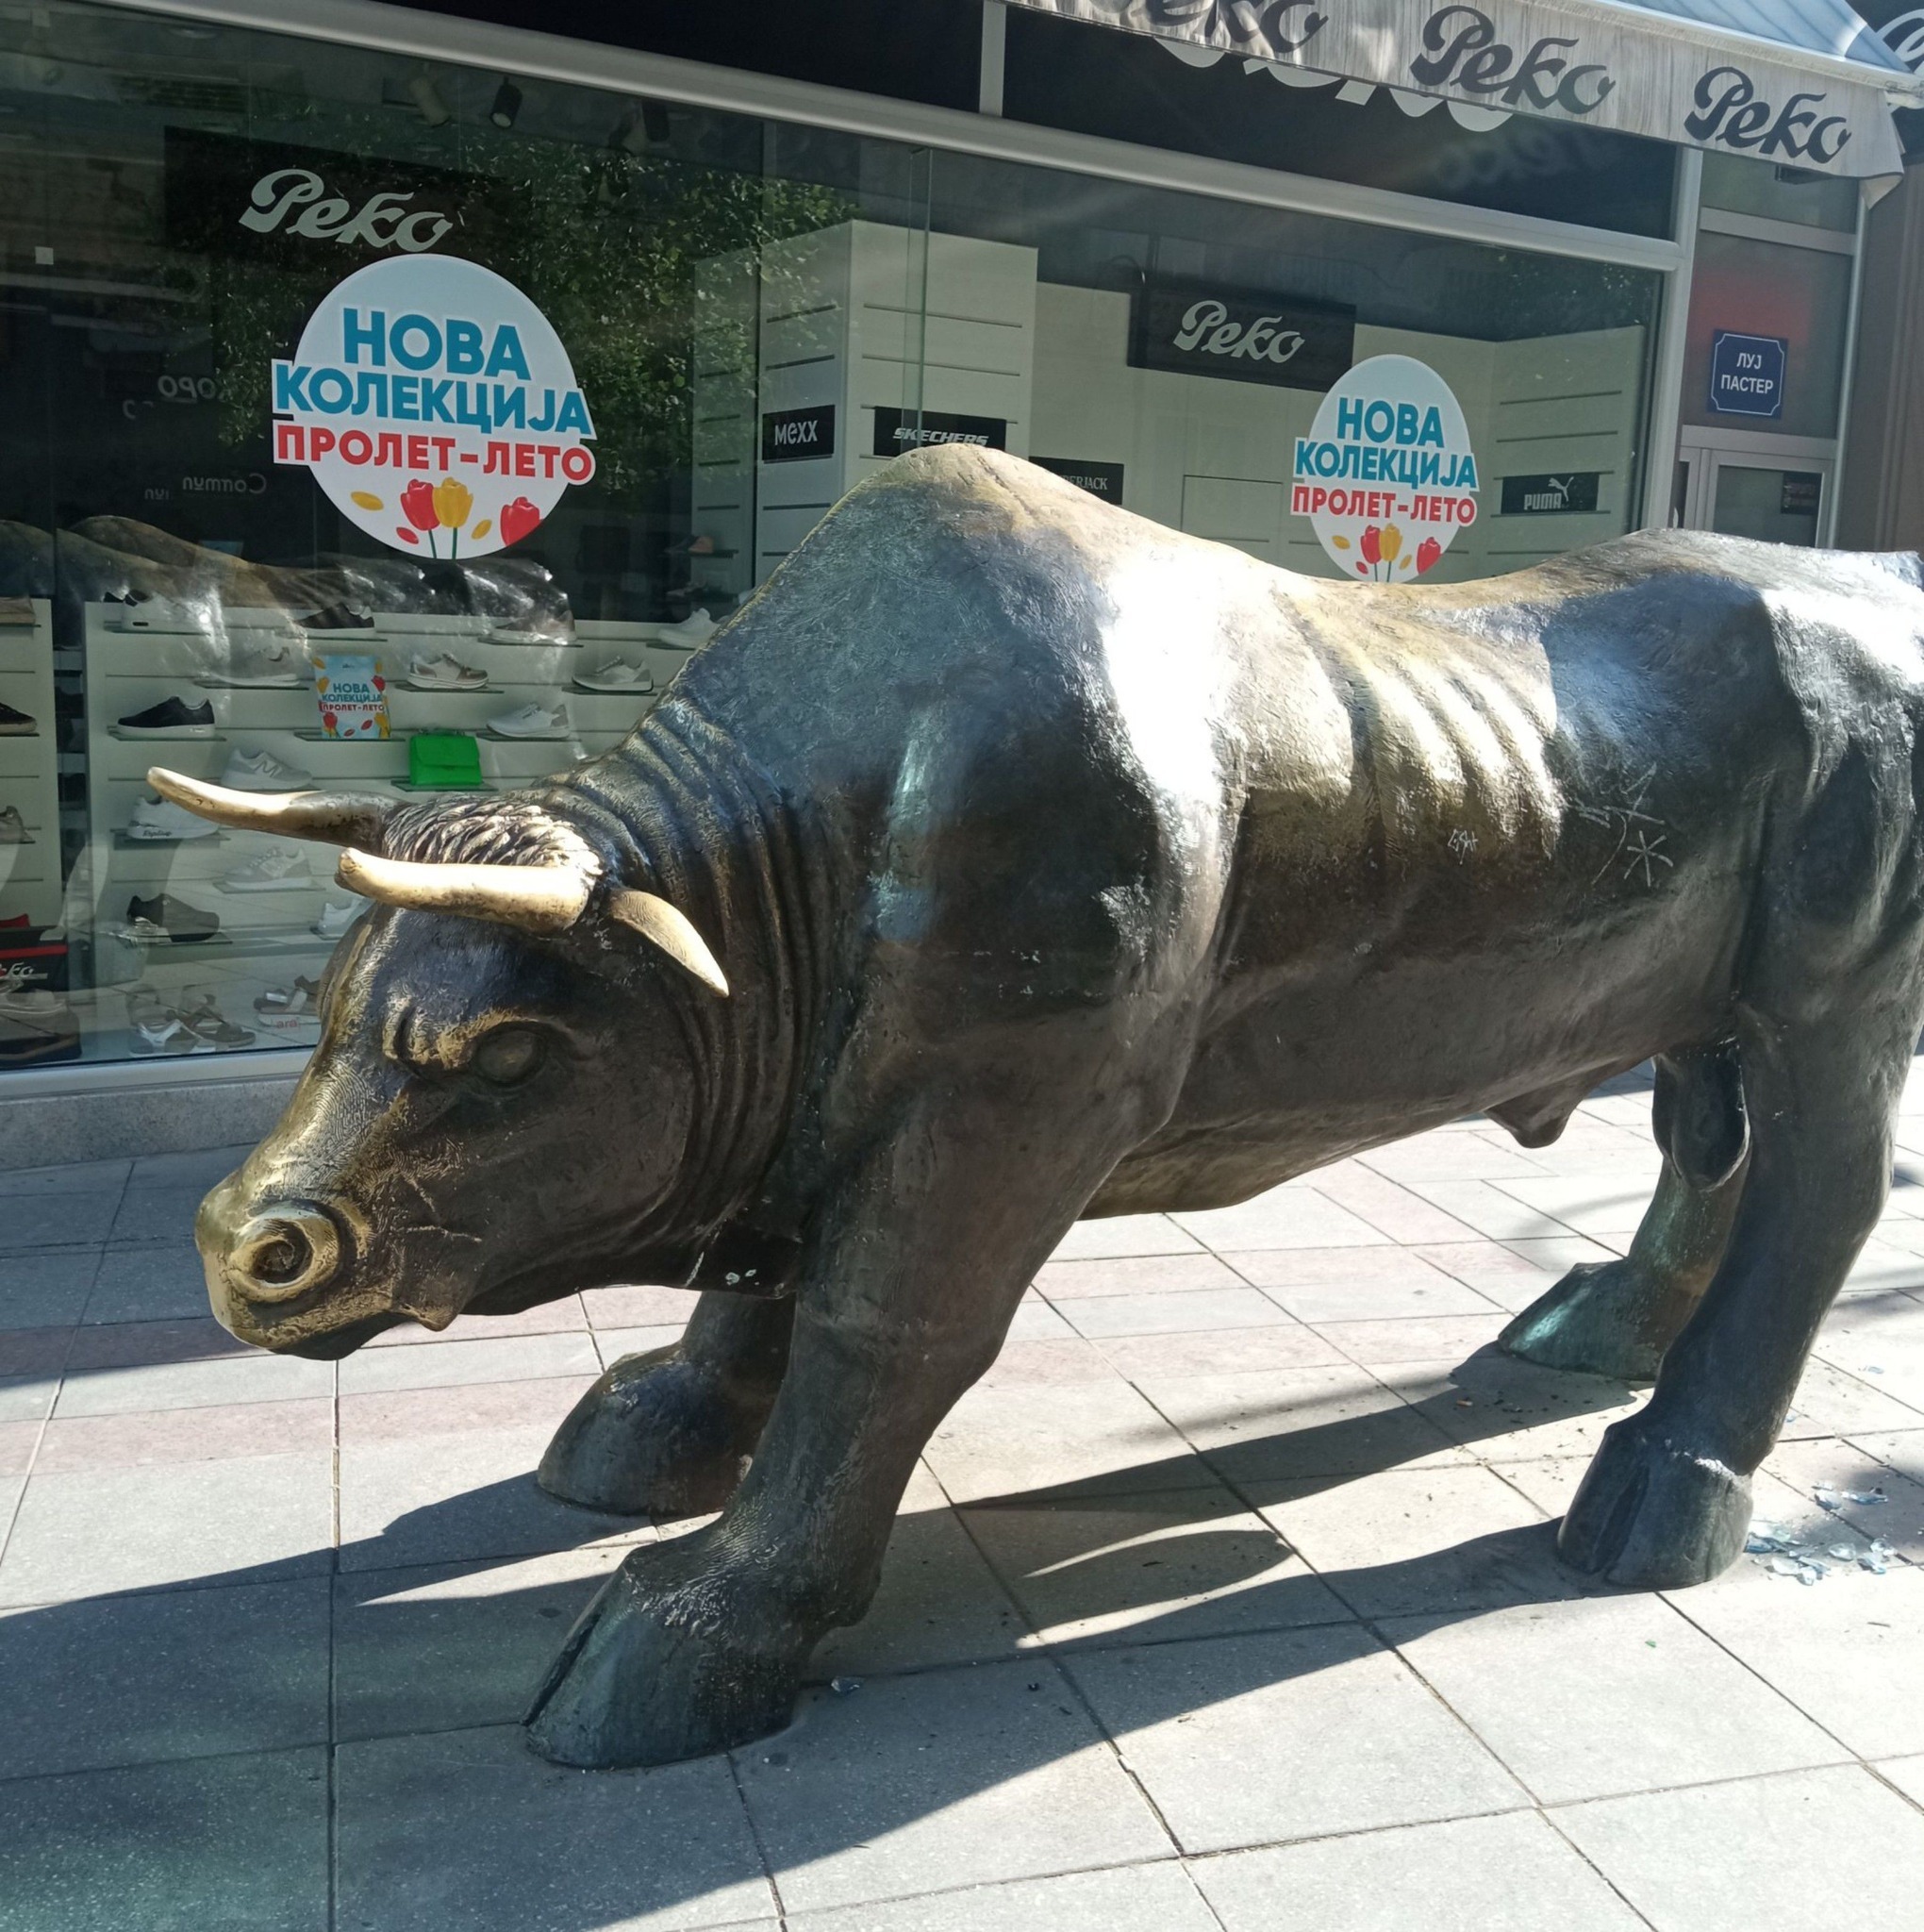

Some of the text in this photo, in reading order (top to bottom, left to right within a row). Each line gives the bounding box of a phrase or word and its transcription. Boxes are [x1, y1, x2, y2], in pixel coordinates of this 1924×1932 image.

[342, 307, 532, 381] НОВА
[1736, 352, 1763, 370] ЛУЈ
[1720, 374, 1774, 394] ПАСТЕР
[275, 362, 591, 436] КОЛЕКЦИЈА
[1336, 396, 1445, 449] НОВА
[892, 427, 989, 446] SKECHERS
[277, 425, 592, 481] ПРОЛЕТ-ЛЕТО
[1295, 440, 1477, 490] КОЛЕКЦИЈА
[1292, 485, 1475, 525] ПРОЛЕТ-ЛЕТО
[1524, 492, 1563, 510] PUMA
[333, 683, 370, 693] НОВА
[322, 693, 382, 704] КОЛЕКЦИЈА
[323, 703, 385, 712] ПРОЛЕТ-ЛЕТО
